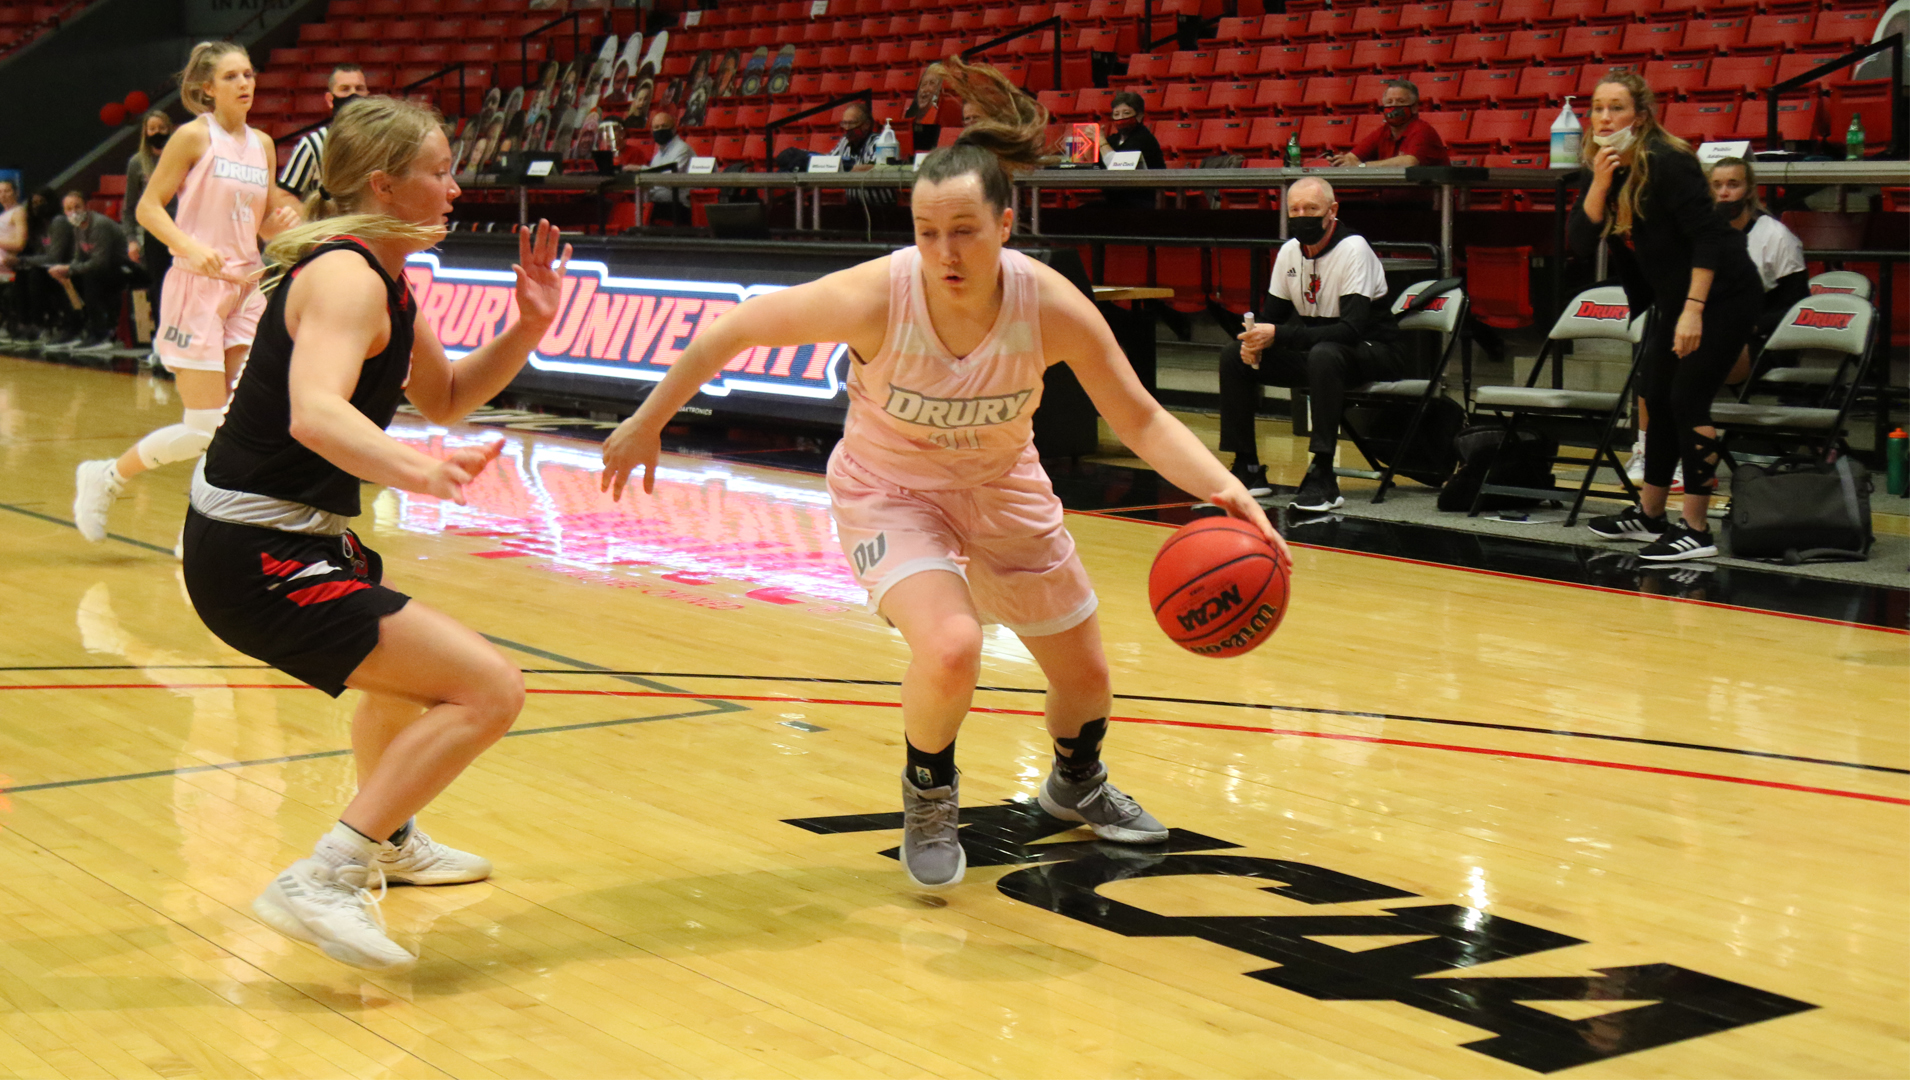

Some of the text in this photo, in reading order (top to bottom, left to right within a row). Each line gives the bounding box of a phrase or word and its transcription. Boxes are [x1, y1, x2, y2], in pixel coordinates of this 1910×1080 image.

[213, 155, 268, 188] DRURY
[538, 275, 838, 380] UNIVE
[1573, 301, 1630, 320] DRURY
[1791, 307, 1857, 330] DRURY
[164, 326, 192, 348] DU
[881, 383, 1034, 429] DRURY
[853, 532, 886, 576] DU
[1176, 584, 1243, 632] NCAA
[1190, 602, 1278, 655] Wilson
[782, 797, 1822, 1075] NCAA
